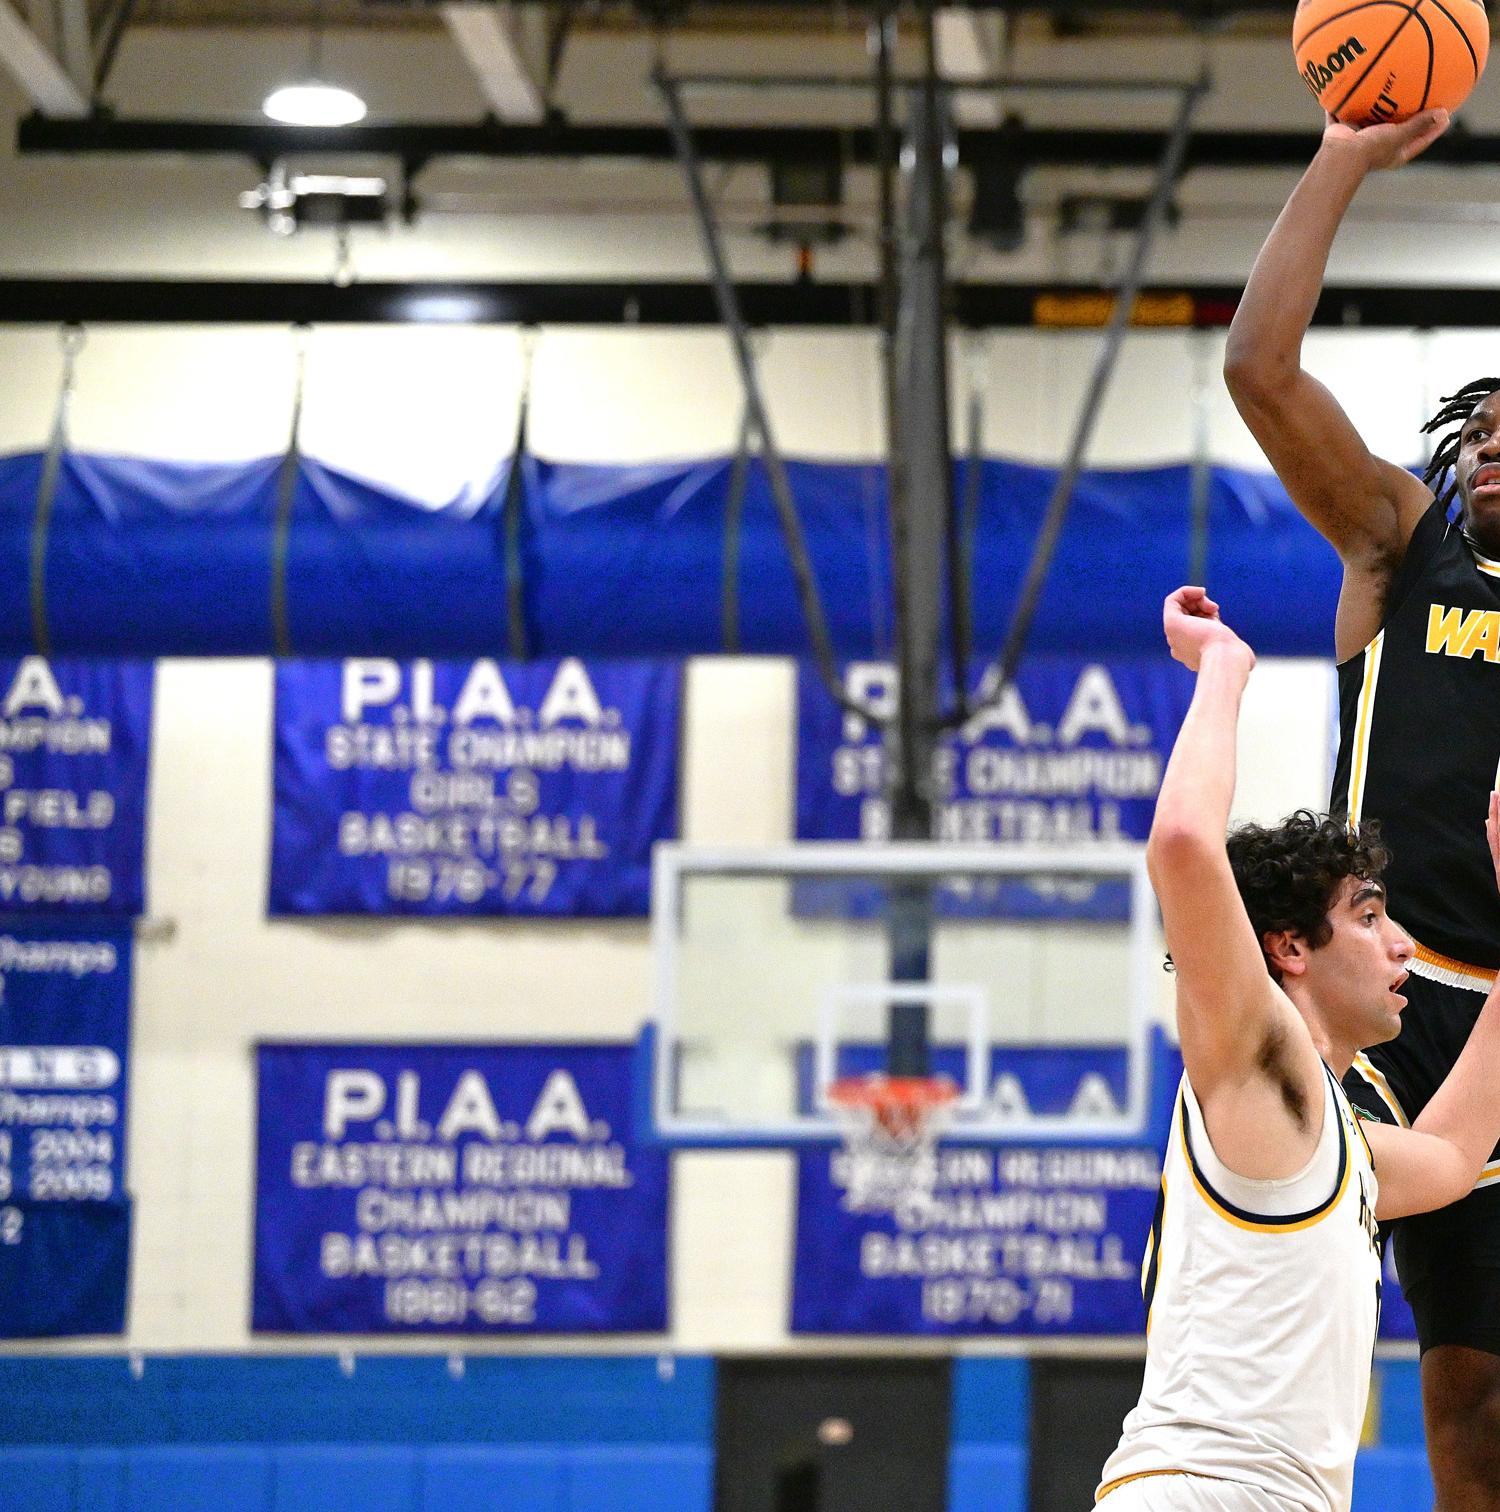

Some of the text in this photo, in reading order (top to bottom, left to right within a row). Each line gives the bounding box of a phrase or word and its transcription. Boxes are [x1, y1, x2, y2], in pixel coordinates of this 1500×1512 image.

[1302, 36, 1367, 97] ilson
[342, 657, 621, 727] P.I.A.A.
[326, 727, 631, 771] STATE CHAMPION
[410, 768, 540, 813] GIRLS
[968, 747, 1160, 798] CHAMPION
[338, 813, 606, 859] BASKETBALL
[325, 1068, 609, 1141] P.I.A.A.
[292, 1144, 632, 1187] EASTERN REGIONAL
[356, 1190, 570, 1231] CHAMPION
[896, 1196, 1104, 1231] CHAMPION
[320, 1233, 597, 1279] BASKETBALL
[860, 1234, 1137, 1278] BASKETBALL
